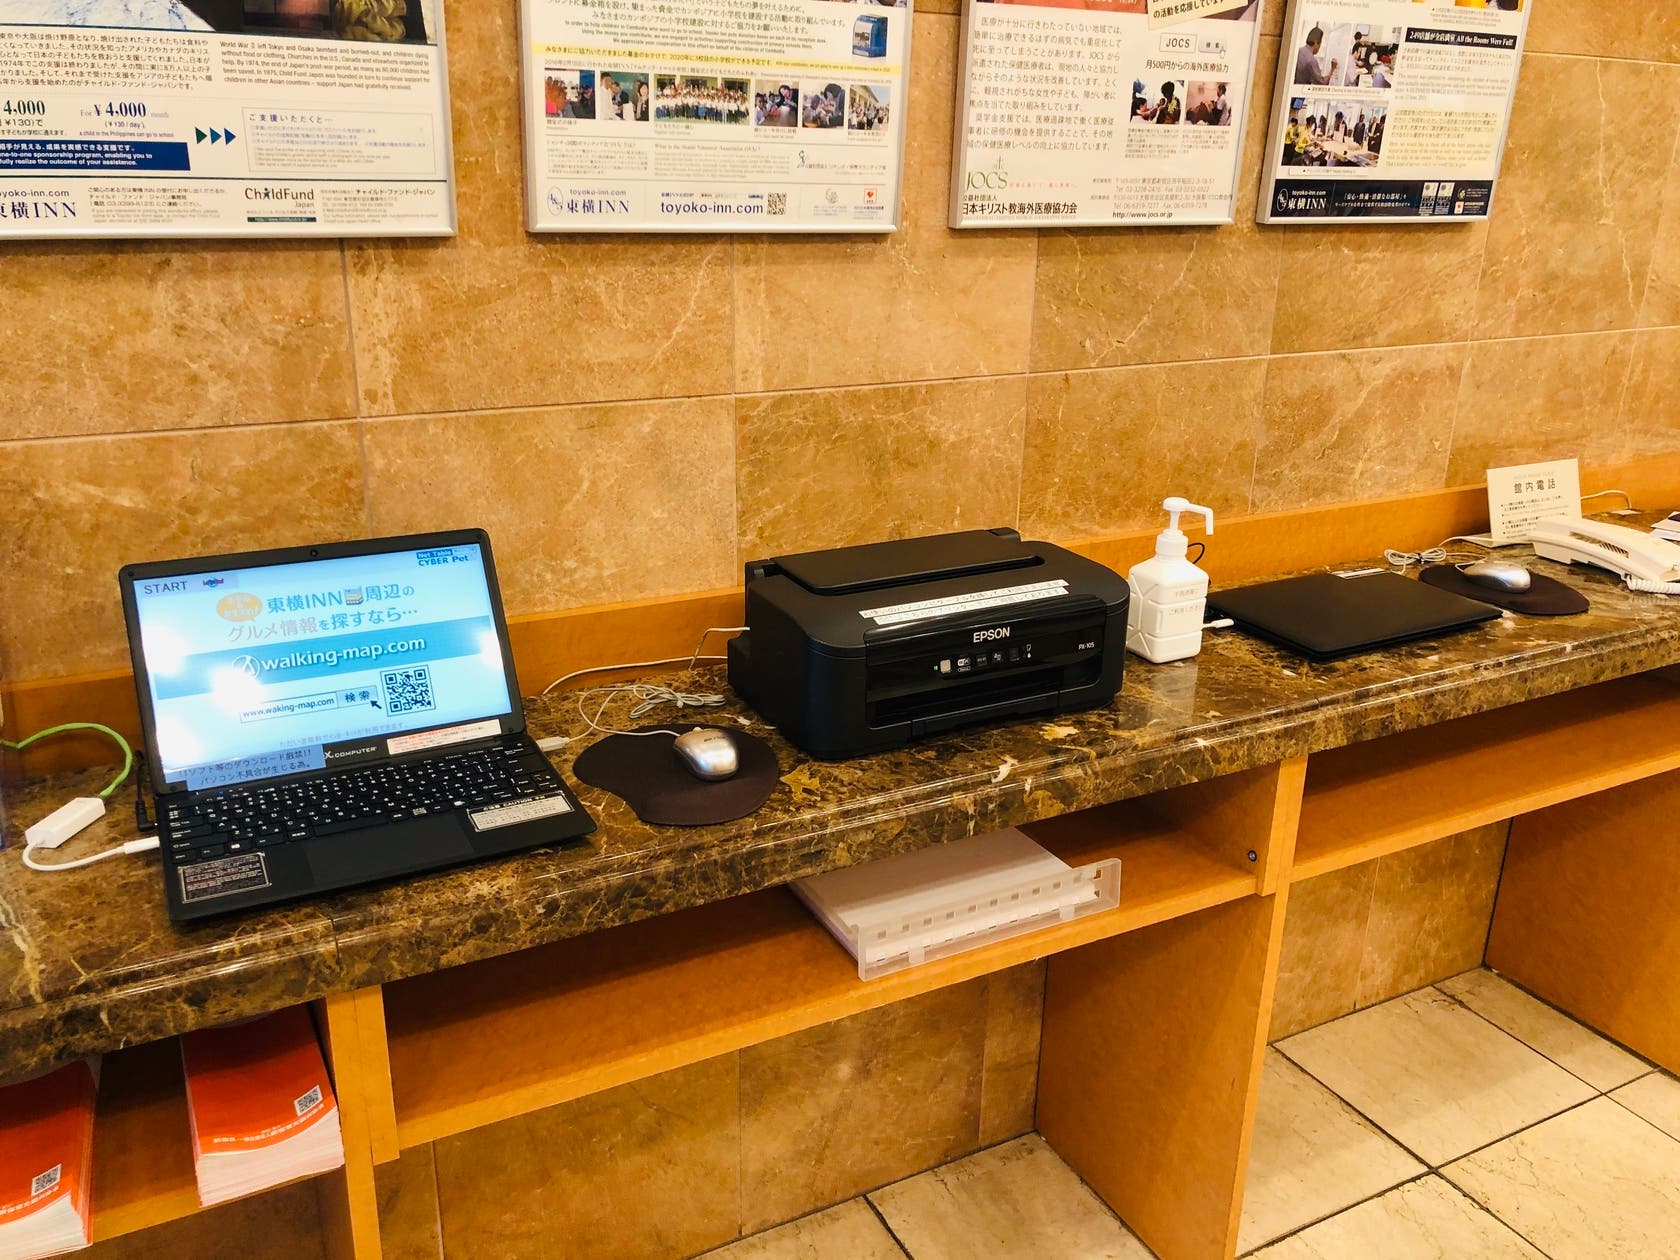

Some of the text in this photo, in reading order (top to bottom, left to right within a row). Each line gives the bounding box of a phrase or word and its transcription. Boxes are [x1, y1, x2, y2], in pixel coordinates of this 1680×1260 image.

[1166, 38, 1190, 48] JOCS
[106, 102, 146, 118] 4,000
[966, 172, 1008, 190] JOCS
[660, 202, 764, 216] toyoko-inn.com
[1514, 478, 1556, 494] 館内電話
[144, 580, 188, 594] START
[973, 626, 1010, 642] EPSON
[261, 637, 426, 672] walking-map.com
[345, 690, 370, 703] 検索
